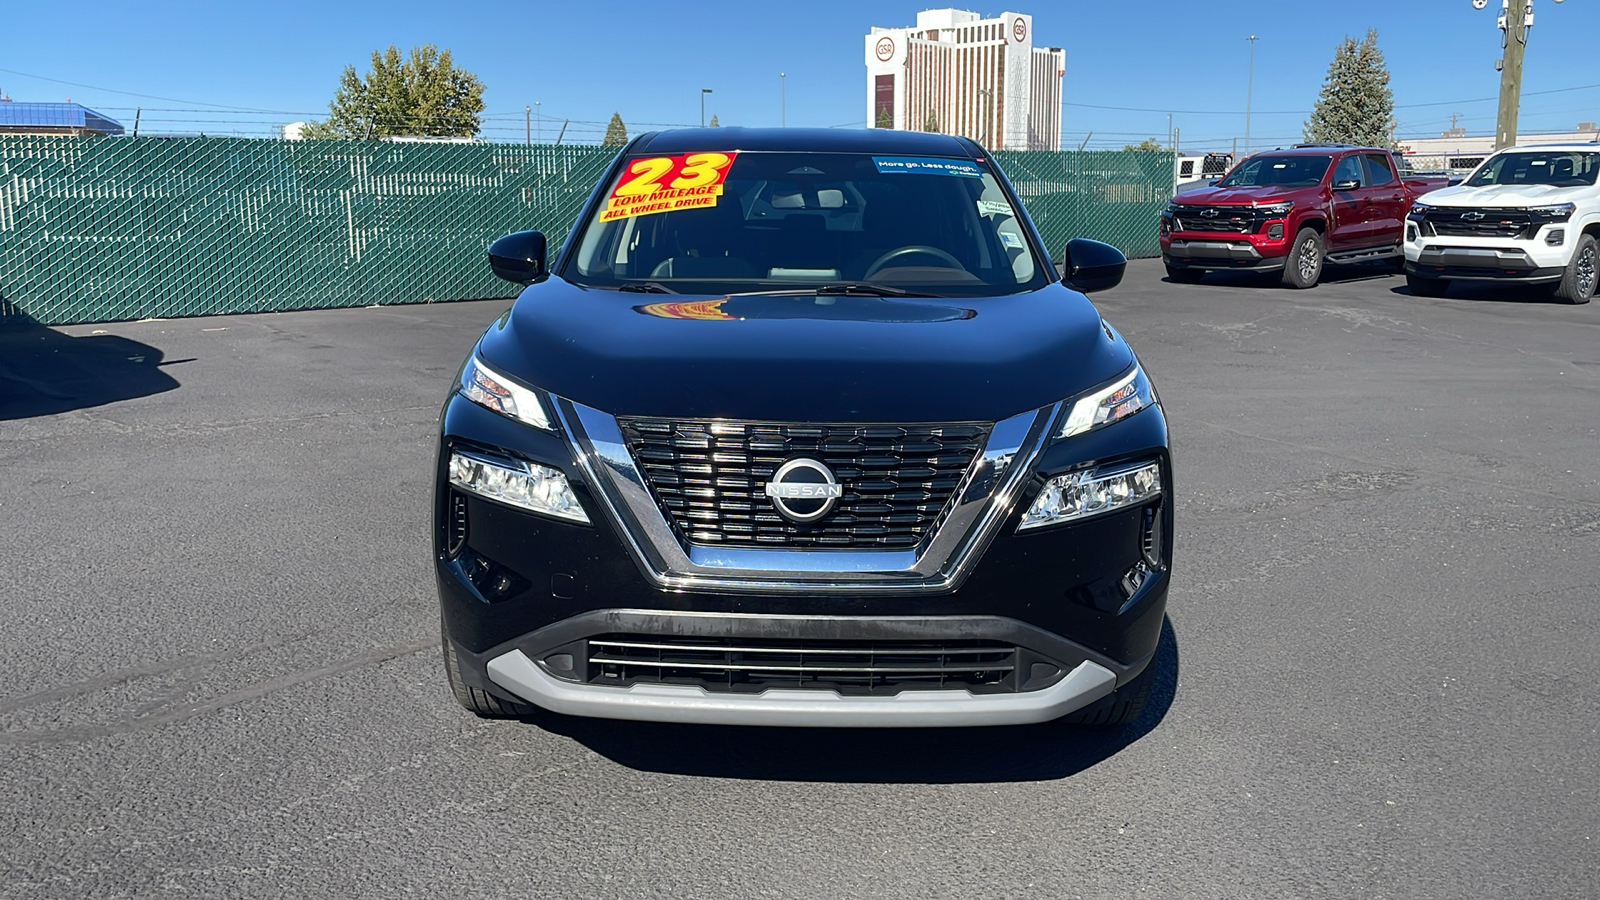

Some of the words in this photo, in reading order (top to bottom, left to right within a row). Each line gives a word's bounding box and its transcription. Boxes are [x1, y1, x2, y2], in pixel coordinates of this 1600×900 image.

[1014, 24, 1025, 35] GSR
[878, 44, 892, 55] GSR
[944, 164, 977, 172] dough.
[615, 152, 731, 197] 23
[613, 193, 648, 208] LOW
[649, 185, 718, 201] MILEAGE
[603, 208, 628, 220] ALL
[630, 202, 672, 215] WHEEL
[674, 197, 712, 208] DRIVE
[768, 485, 840, 496] NISSAN
